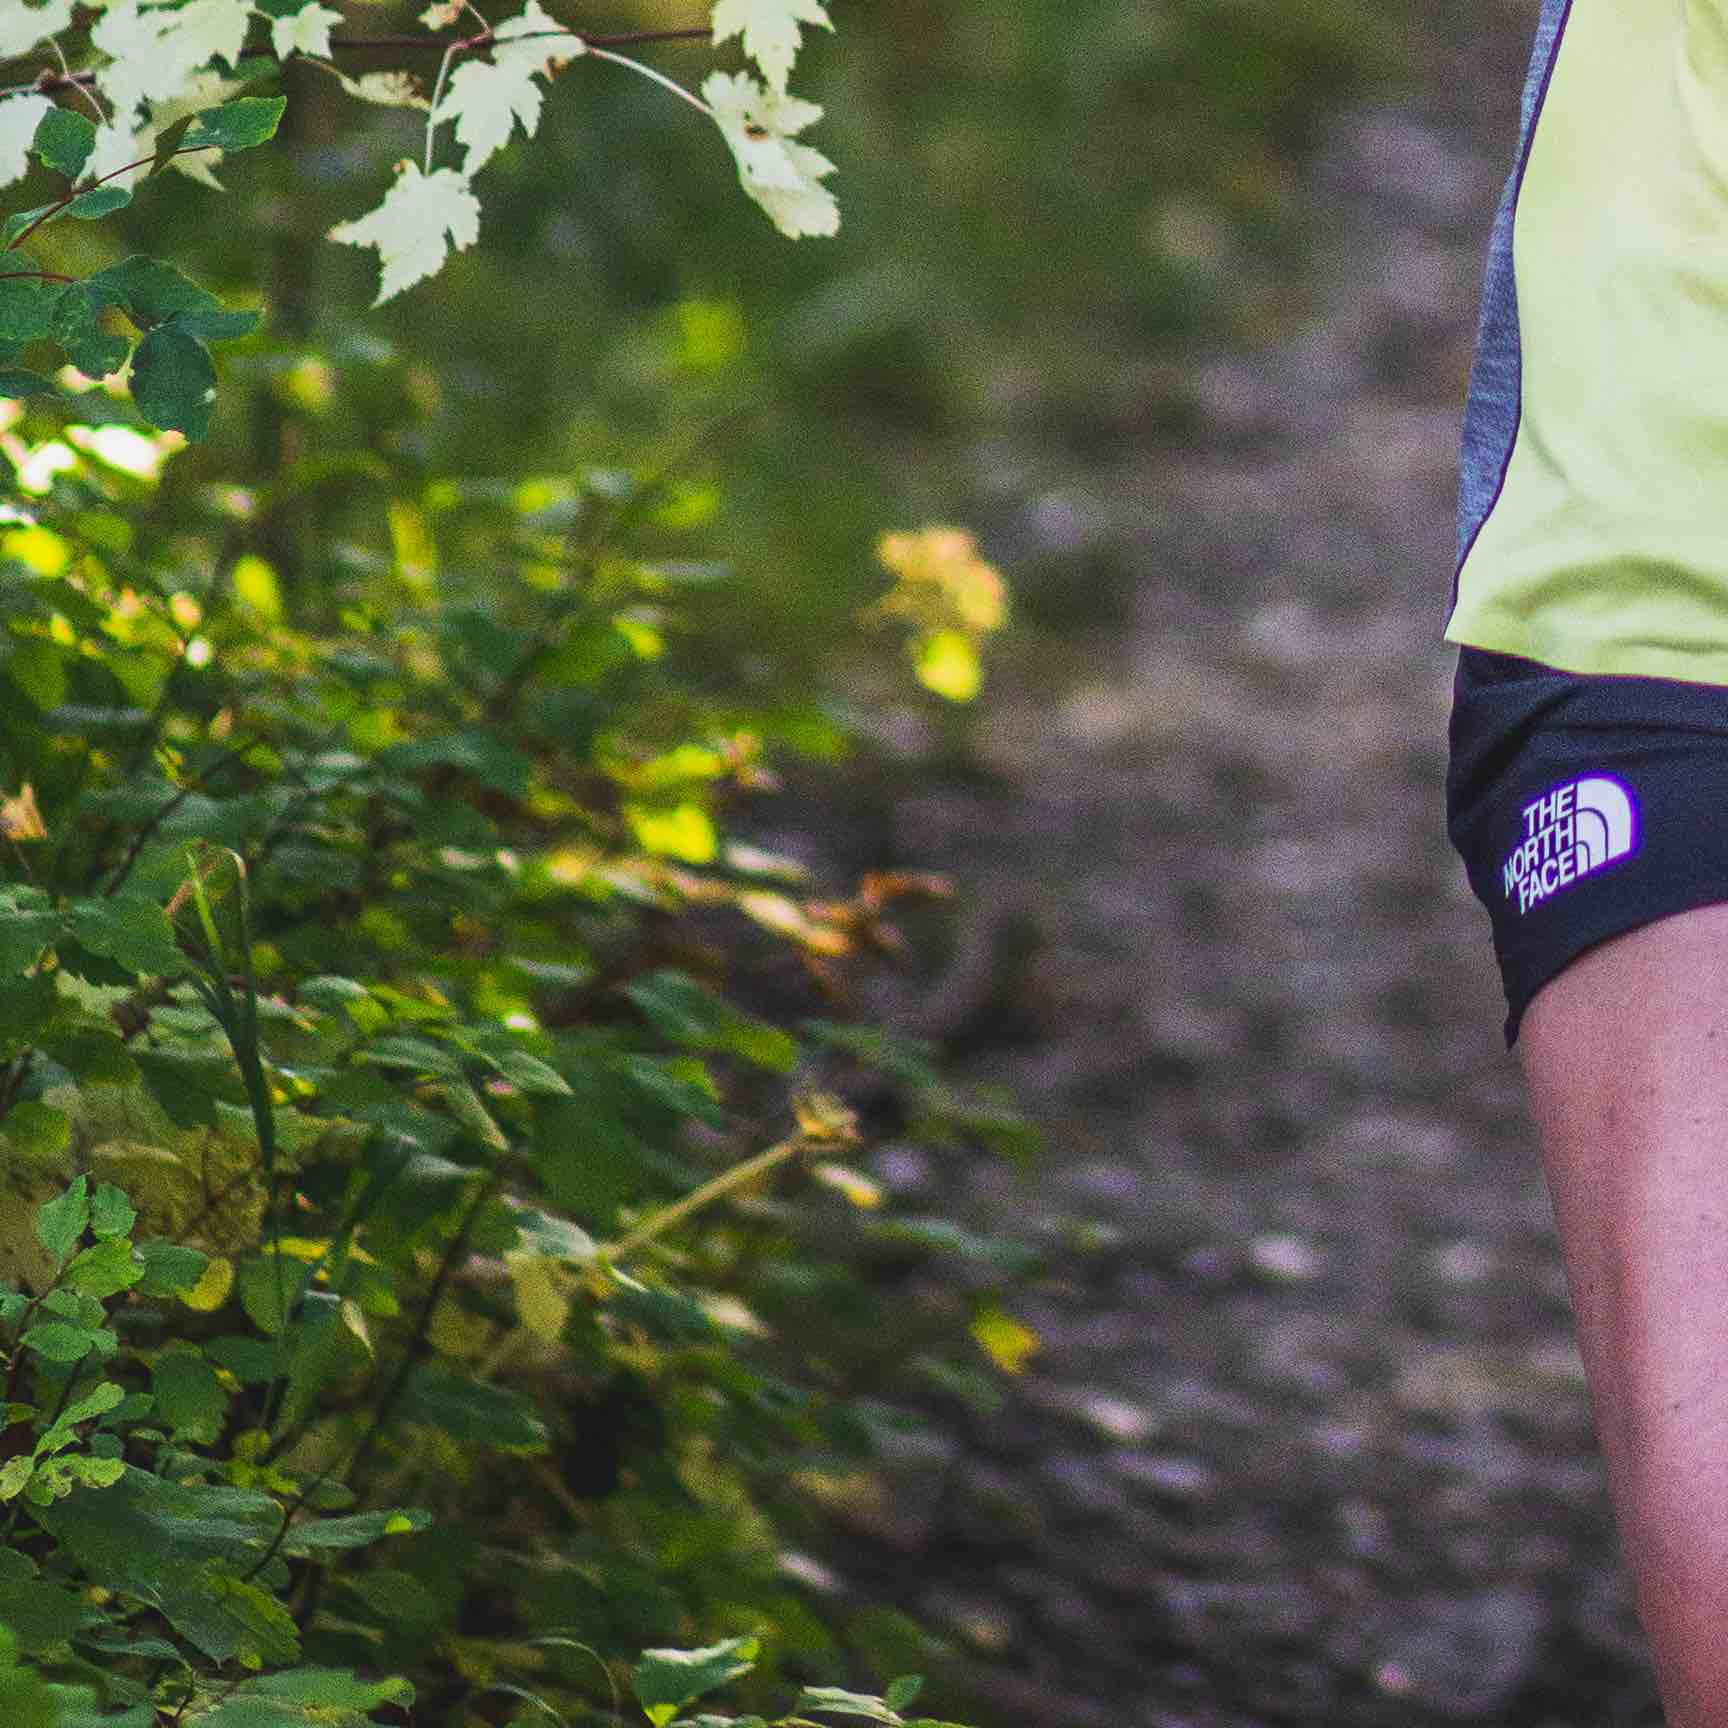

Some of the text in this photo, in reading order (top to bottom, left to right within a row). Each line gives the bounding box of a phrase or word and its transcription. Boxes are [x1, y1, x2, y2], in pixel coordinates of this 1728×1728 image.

[1522, 783, 1575, 837] THE
[1503, 815, 1574, 898] NORTH
[1518, 848, 1576, 916] FACE
